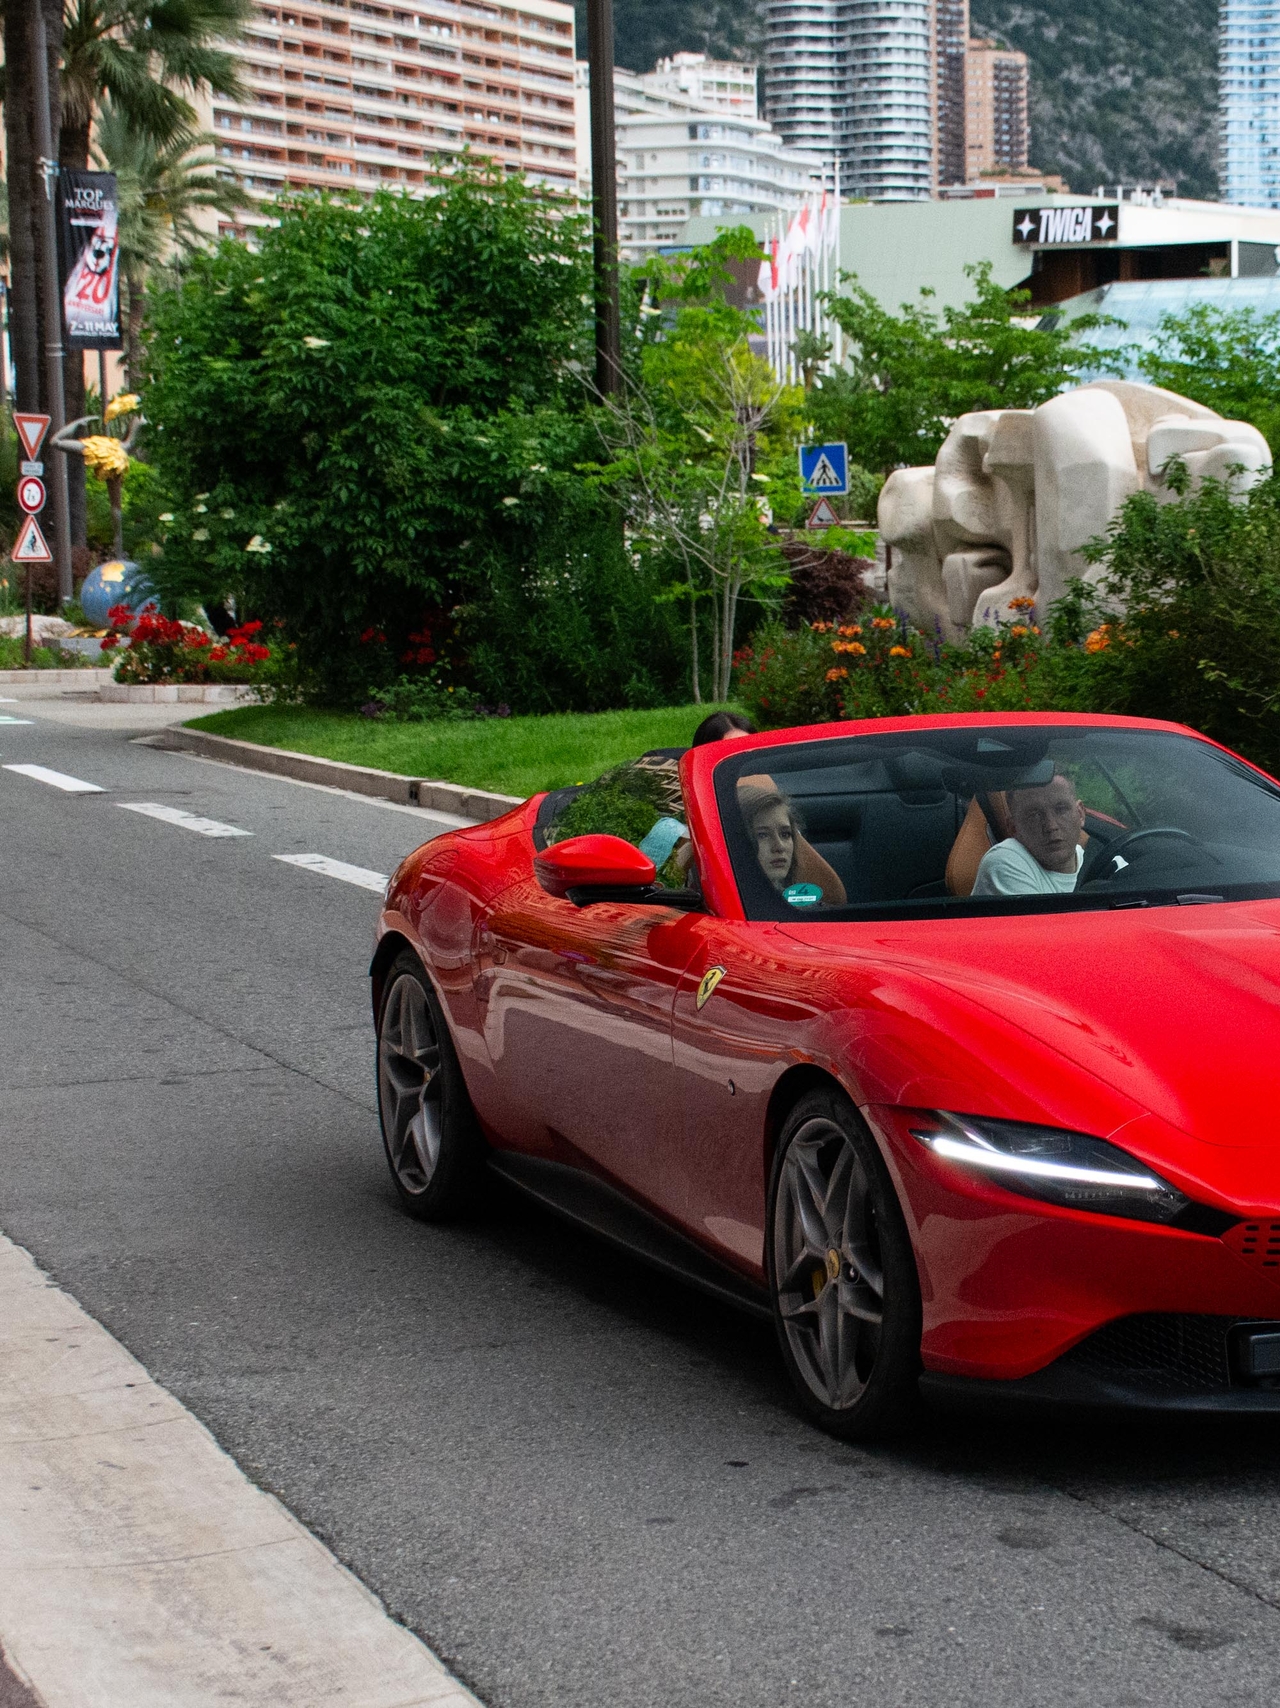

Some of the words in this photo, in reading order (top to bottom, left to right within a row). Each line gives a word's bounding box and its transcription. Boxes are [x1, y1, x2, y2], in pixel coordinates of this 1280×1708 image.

[74, 187, 104, 201] TOP
[65, 198, 114, 211] MARQUES
[1039, 207, 1092, 243] TWIGA
[76, 268, 112, 304] 20
[95, 321, 119, 333] MAY
